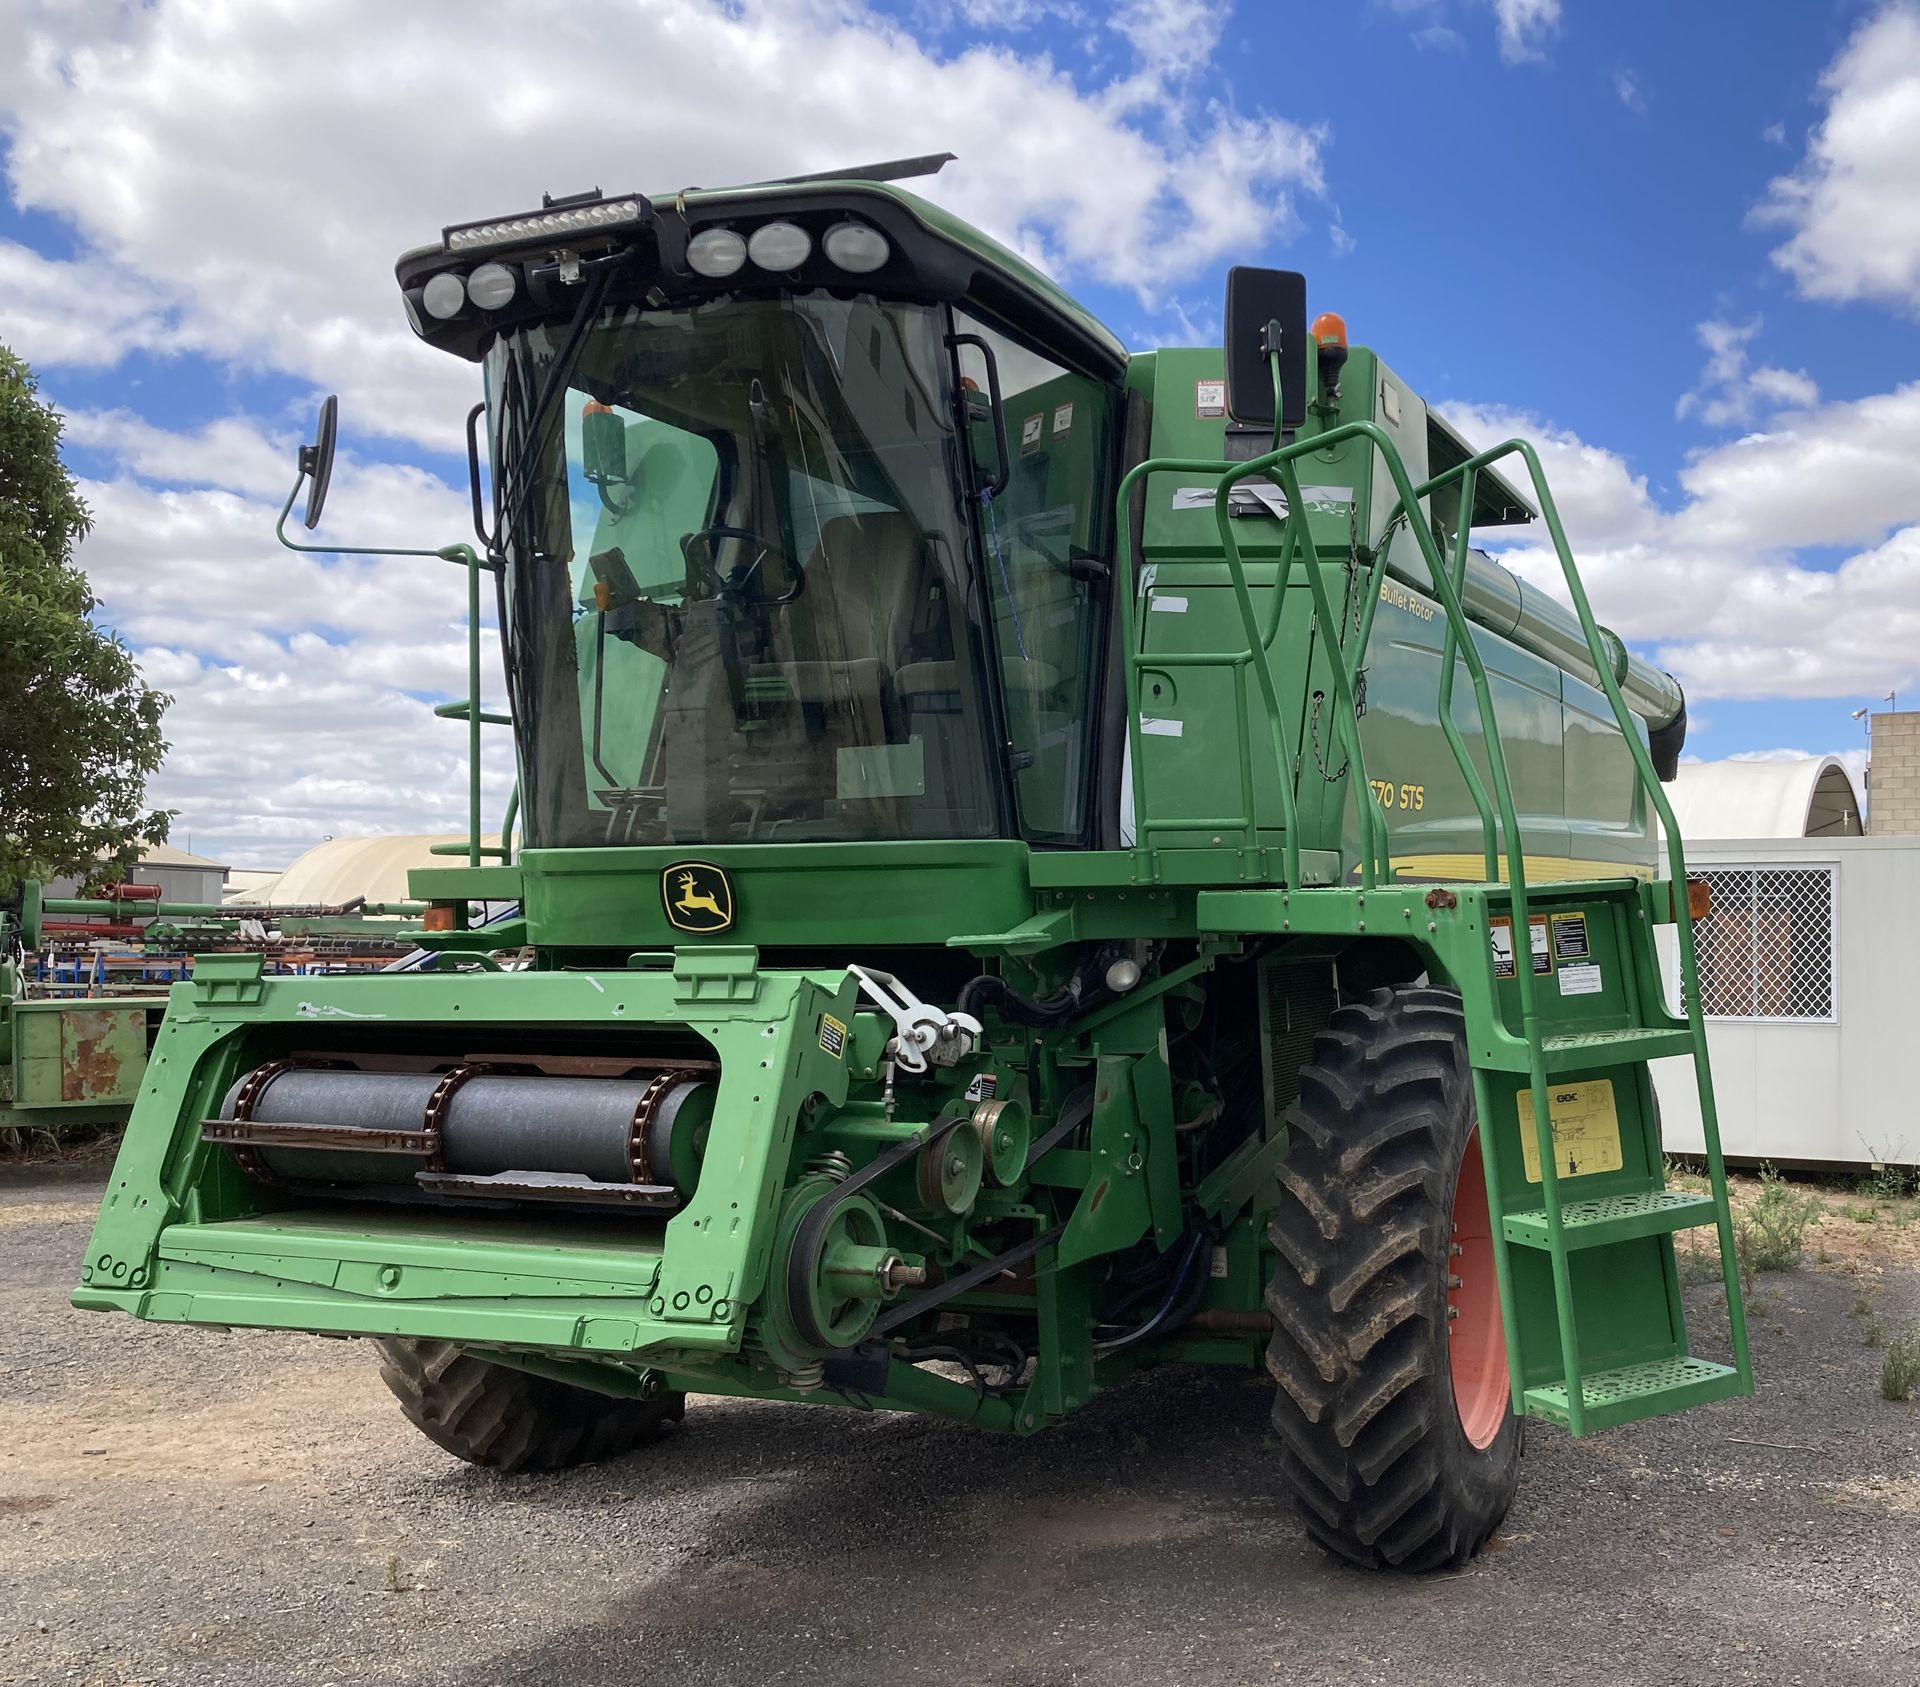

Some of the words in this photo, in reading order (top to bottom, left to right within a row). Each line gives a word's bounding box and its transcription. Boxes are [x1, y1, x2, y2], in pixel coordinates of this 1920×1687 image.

[1380, 583, 1408, 611] Bullet
[1408, 597, 1434, 623] Rotor
[1399, 783, 1424, 811] STS
